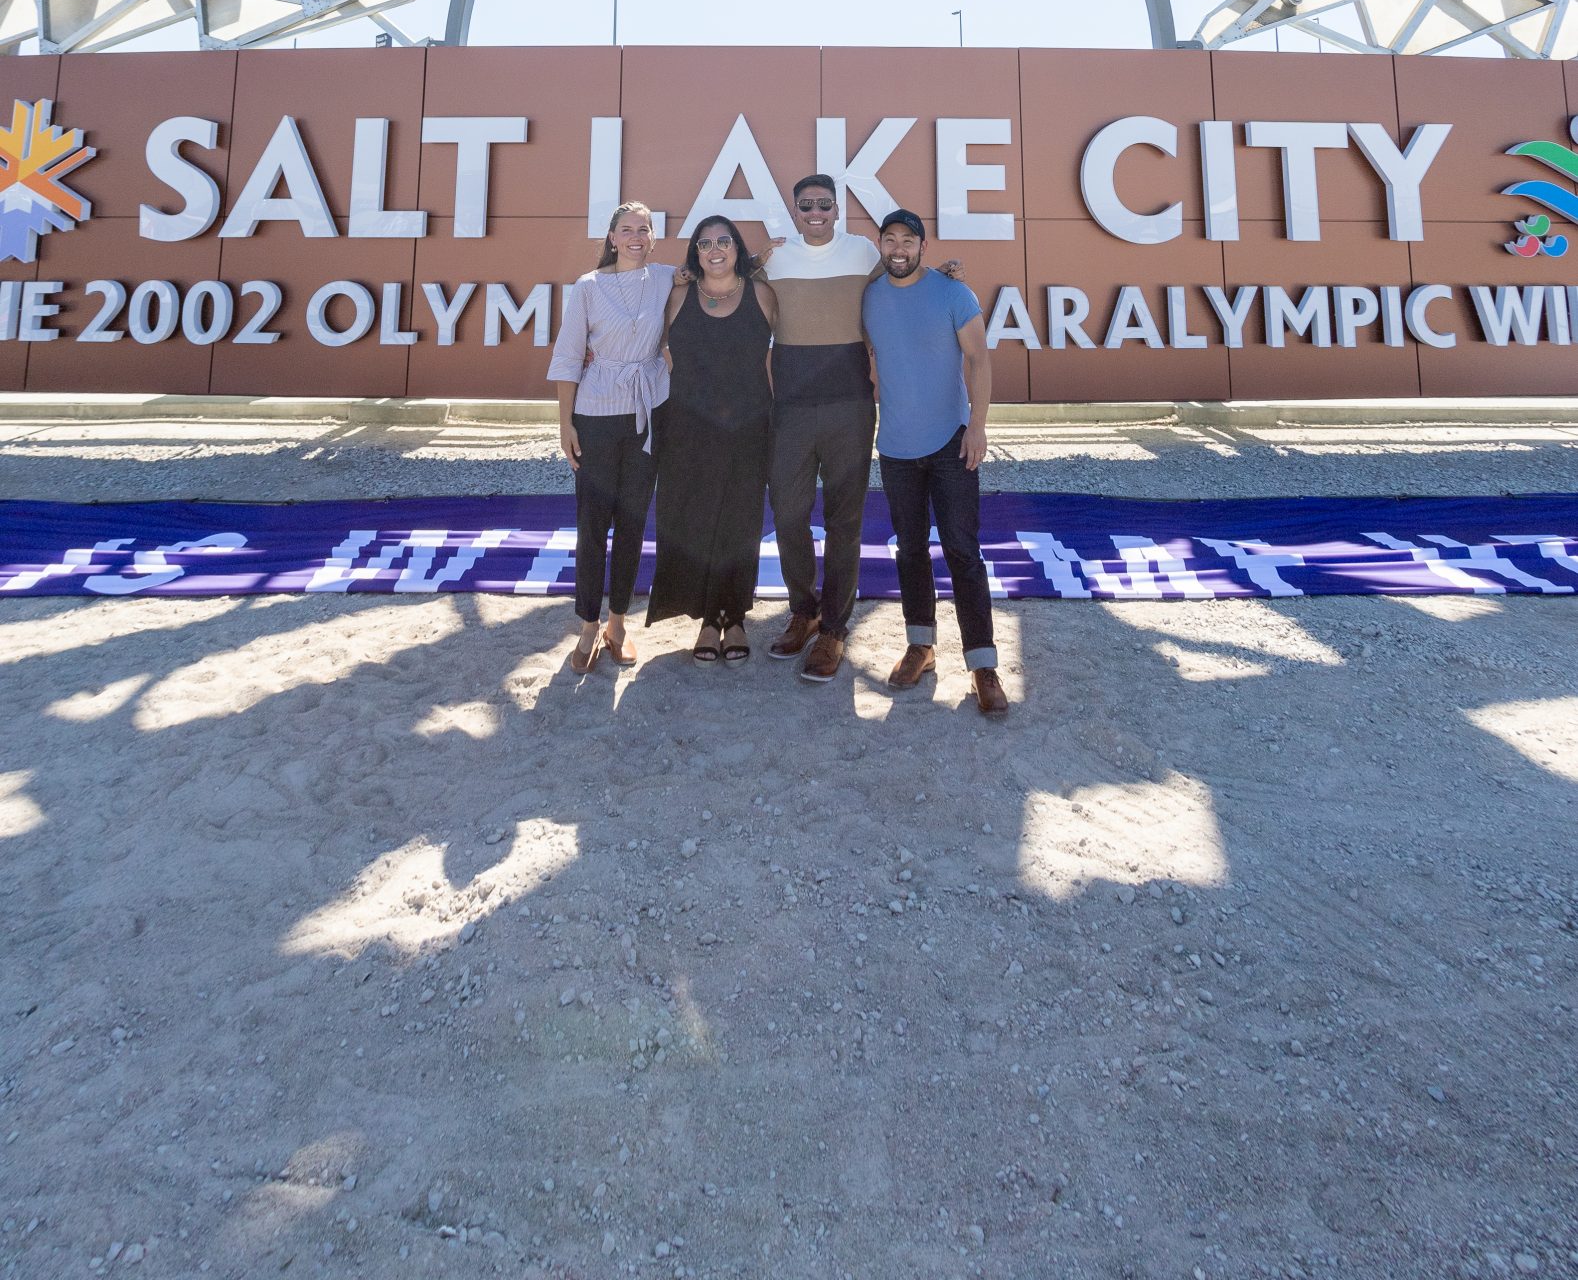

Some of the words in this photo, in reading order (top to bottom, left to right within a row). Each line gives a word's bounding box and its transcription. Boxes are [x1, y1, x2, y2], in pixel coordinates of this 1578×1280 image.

[139, 114, 528, 242] SALT
[587, 113, 1017, 241] LAKE
[1080, 115, 1454, 245] CITY
[76, 279, 282, 345] 2002
[306, 280, 577, 347] OLYM
[985, 283, 1457, 349] ARALYMPIC
